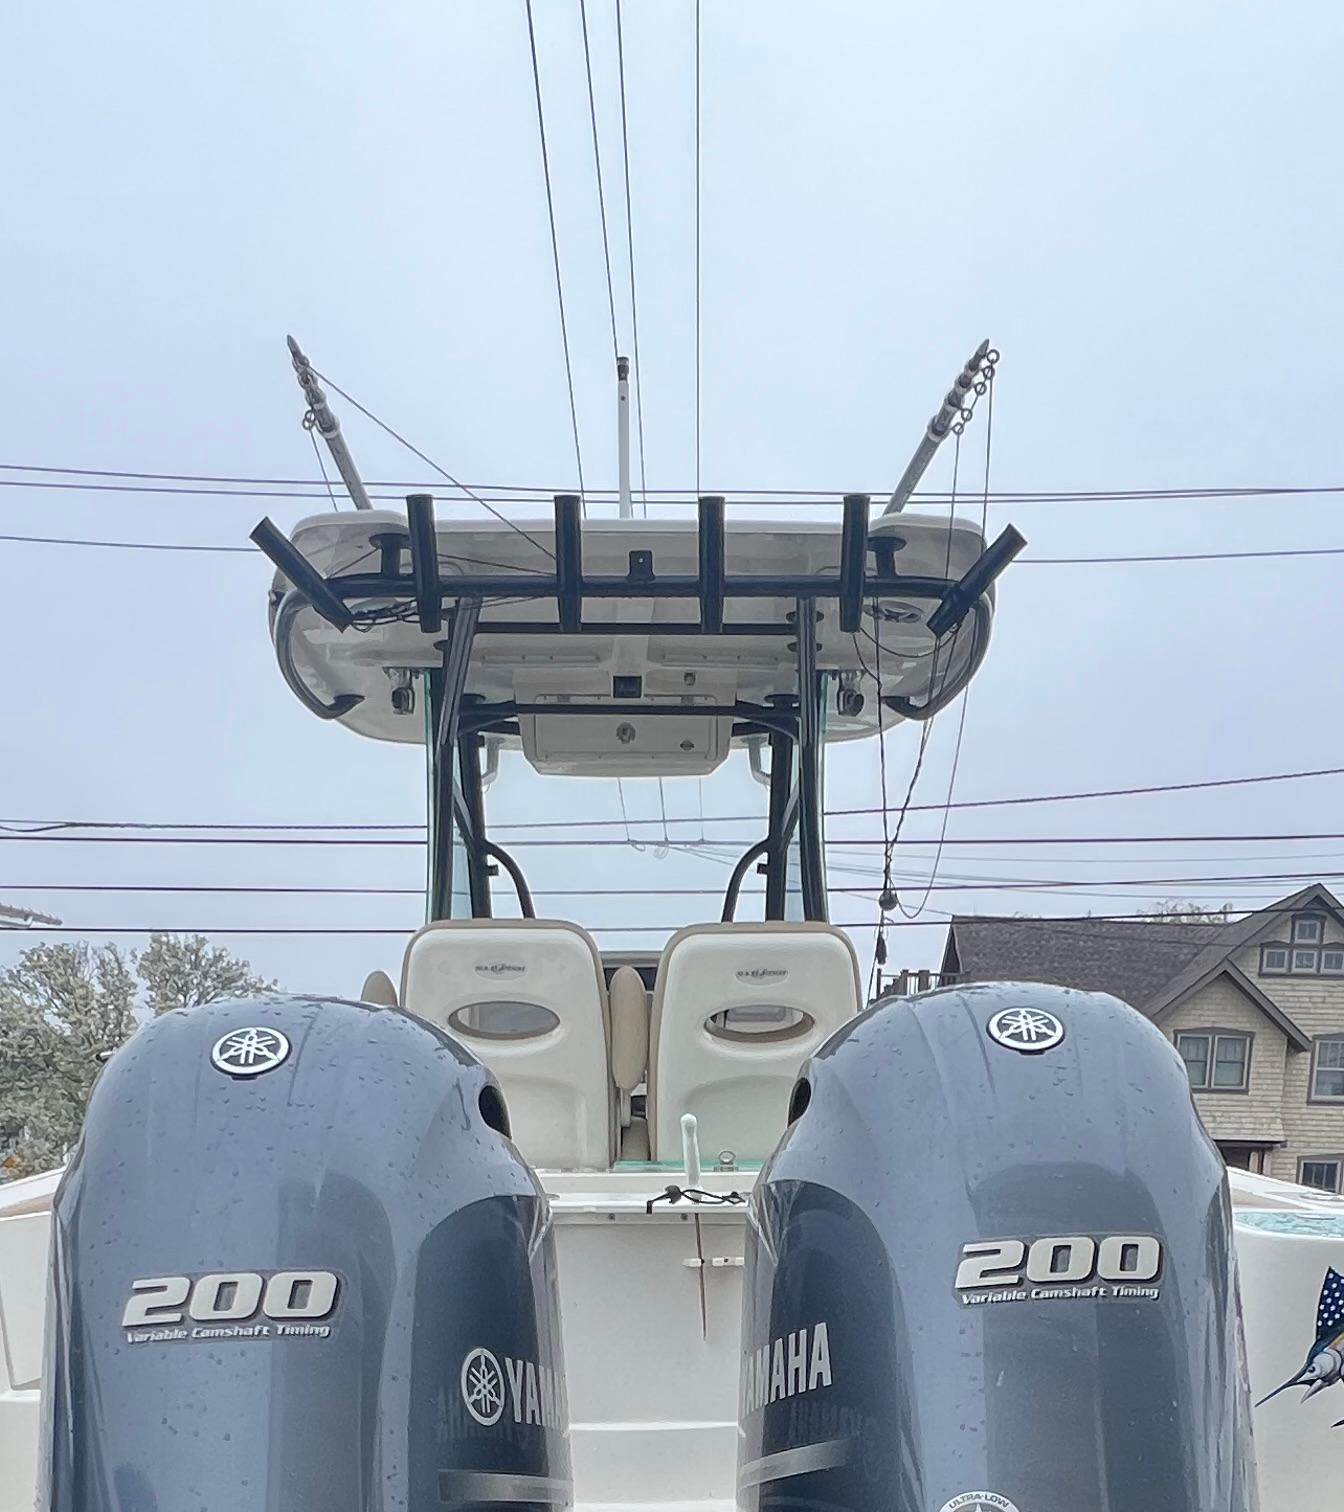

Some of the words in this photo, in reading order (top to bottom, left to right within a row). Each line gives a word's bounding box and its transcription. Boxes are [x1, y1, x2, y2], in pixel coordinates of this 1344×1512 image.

[955, 1236, 1161, 1289] 200
[122, 1271, 339, 1328] 200
[962, 1289, 1027, 1305] Variable
[1031, 1285, 1107, 1300] Camshaft
[1111, 1284, 1160, 1299] Timing
[127, 1328, 188, 1344] Variable
[191, 1324, 271, 1340] Camshaft
[275, 1323, 331, 1338] Timing
